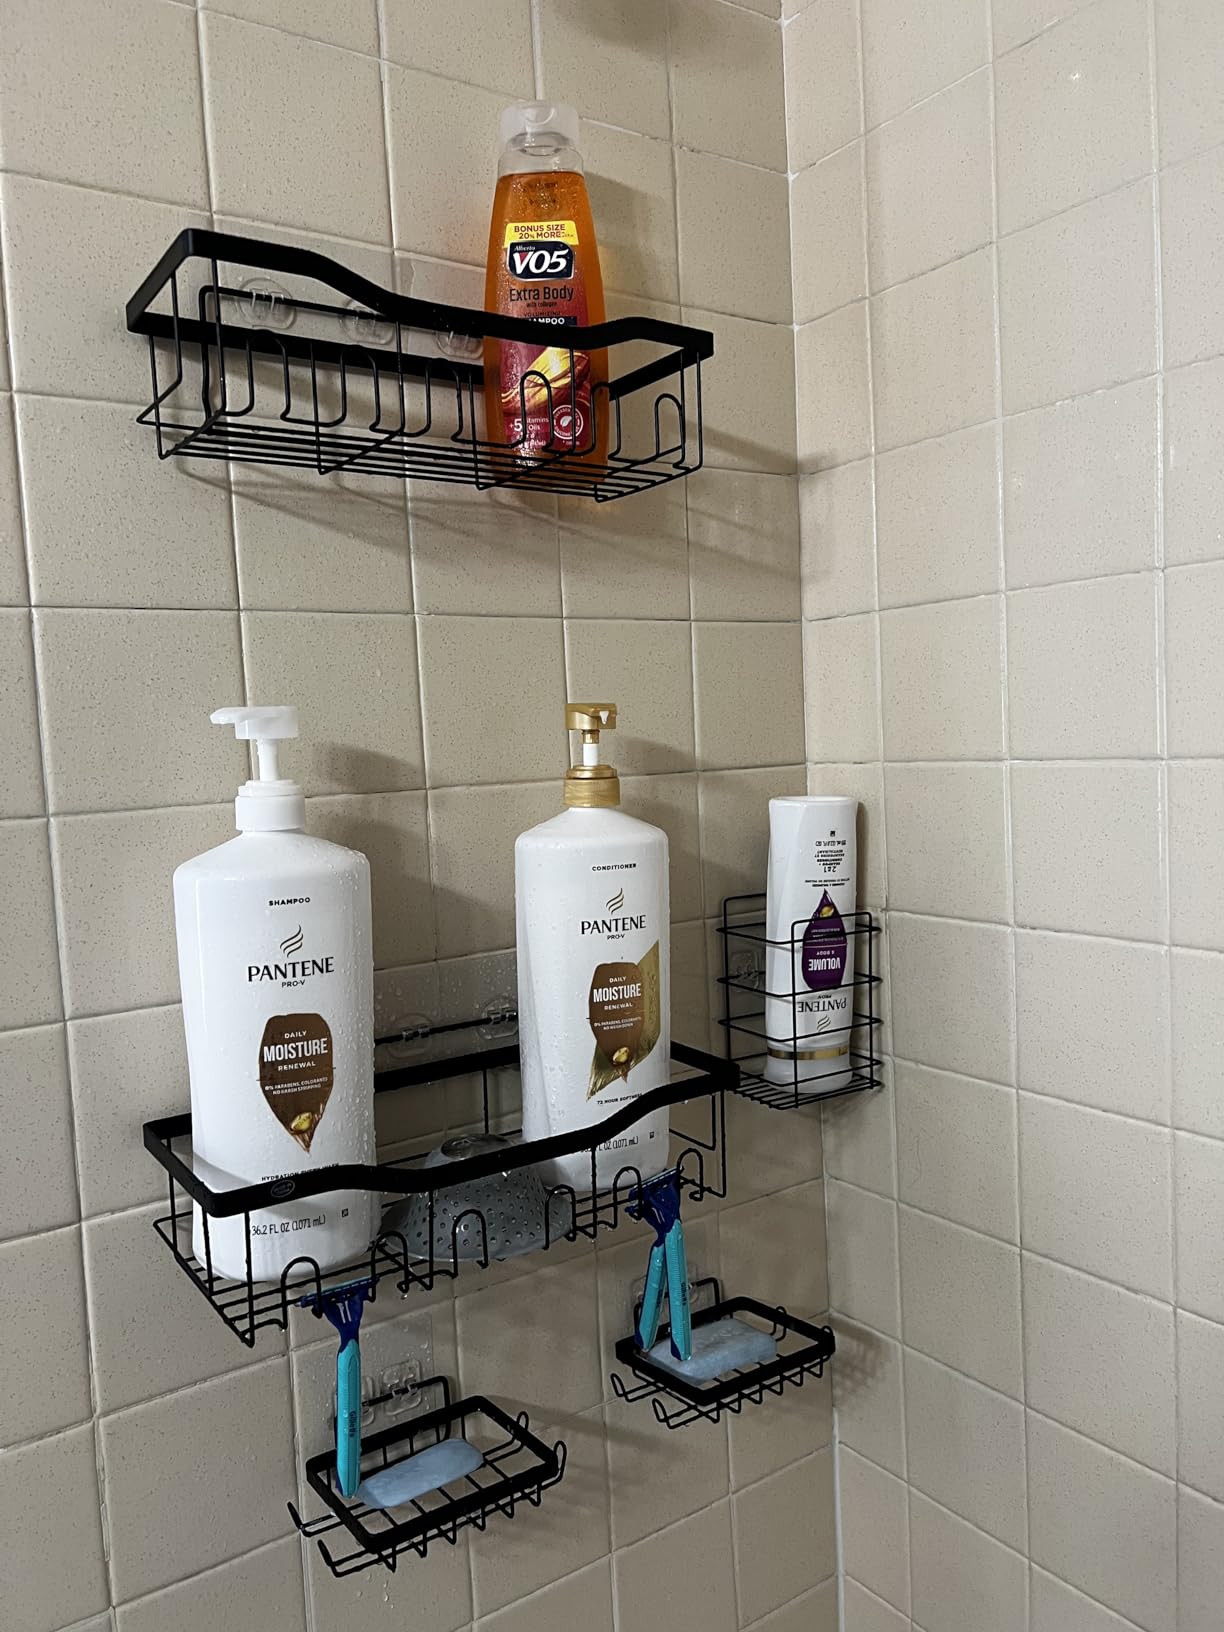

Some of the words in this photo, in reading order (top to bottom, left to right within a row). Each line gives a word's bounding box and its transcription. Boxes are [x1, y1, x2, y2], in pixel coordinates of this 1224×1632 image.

[514, 225, 544, 233] BONUS
[536, 231, 561, 239] MORE
[512, 249, 569, 275] VO5
[509, 288, 540, 302] Extra
[543, 286, 574, 301] Body
[592, 863, 637, 872] CONDITIONER
[268, 897, 311, 906] SHAMPOO
[581, 914, 647, 935] PANTENE
[247, 956, 335, 982] PANTENE
[808, 957, 841, 971] VOLUME
[593, 983, 642, 1003] MOISTURE
[604, 1002, 633, 1011] RENEWAL
[797, 997, 847, 1013] PANTENE
[284, 1030, 307, 1039] DAILY
[263, 1038, 328, 1063] MOISTURE
[278, 1061, 316, 1072] RENEWAL
[603, 1140, 612, 1150] OZ
[251, 1225, 267, 1236] 36.2
[269, 1224, 279, 1234] FL
[280, 1222, 290, 1233] OZ
[291, 1218, 311, 1231] (1071
[312, 1214, 326, 1227] mL)
